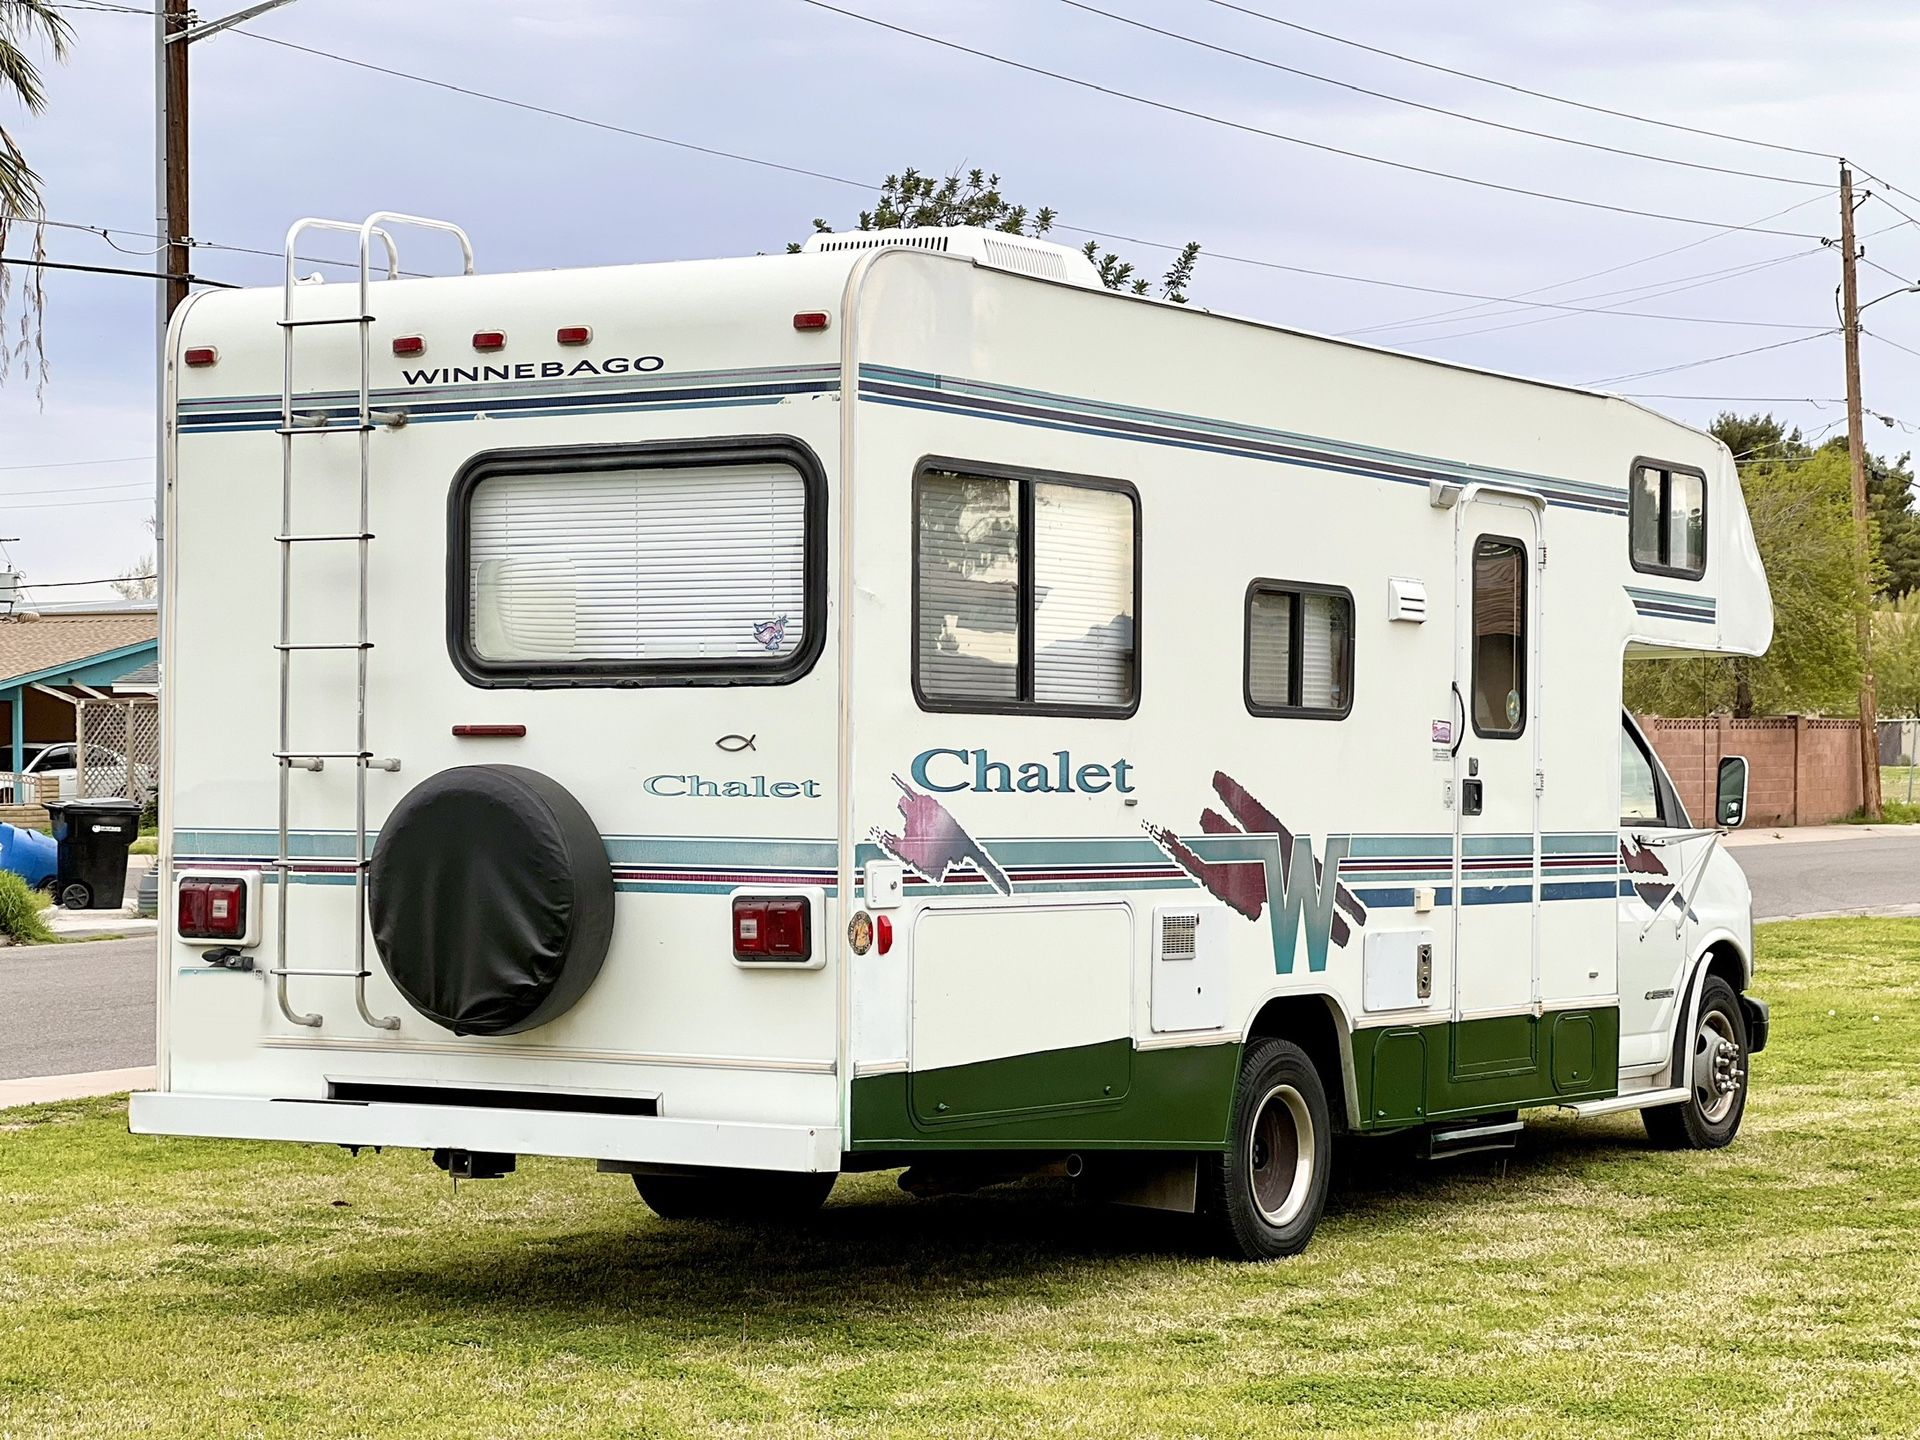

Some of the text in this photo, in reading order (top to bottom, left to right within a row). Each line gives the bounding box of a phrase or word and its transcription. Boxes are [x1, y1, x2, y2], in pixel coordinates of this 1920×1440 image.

[402, 356, 664, 385] WINNEBAGO
[911, 748, 1135, 793] Chalet
[643, 774, 822, 798] Chalet
